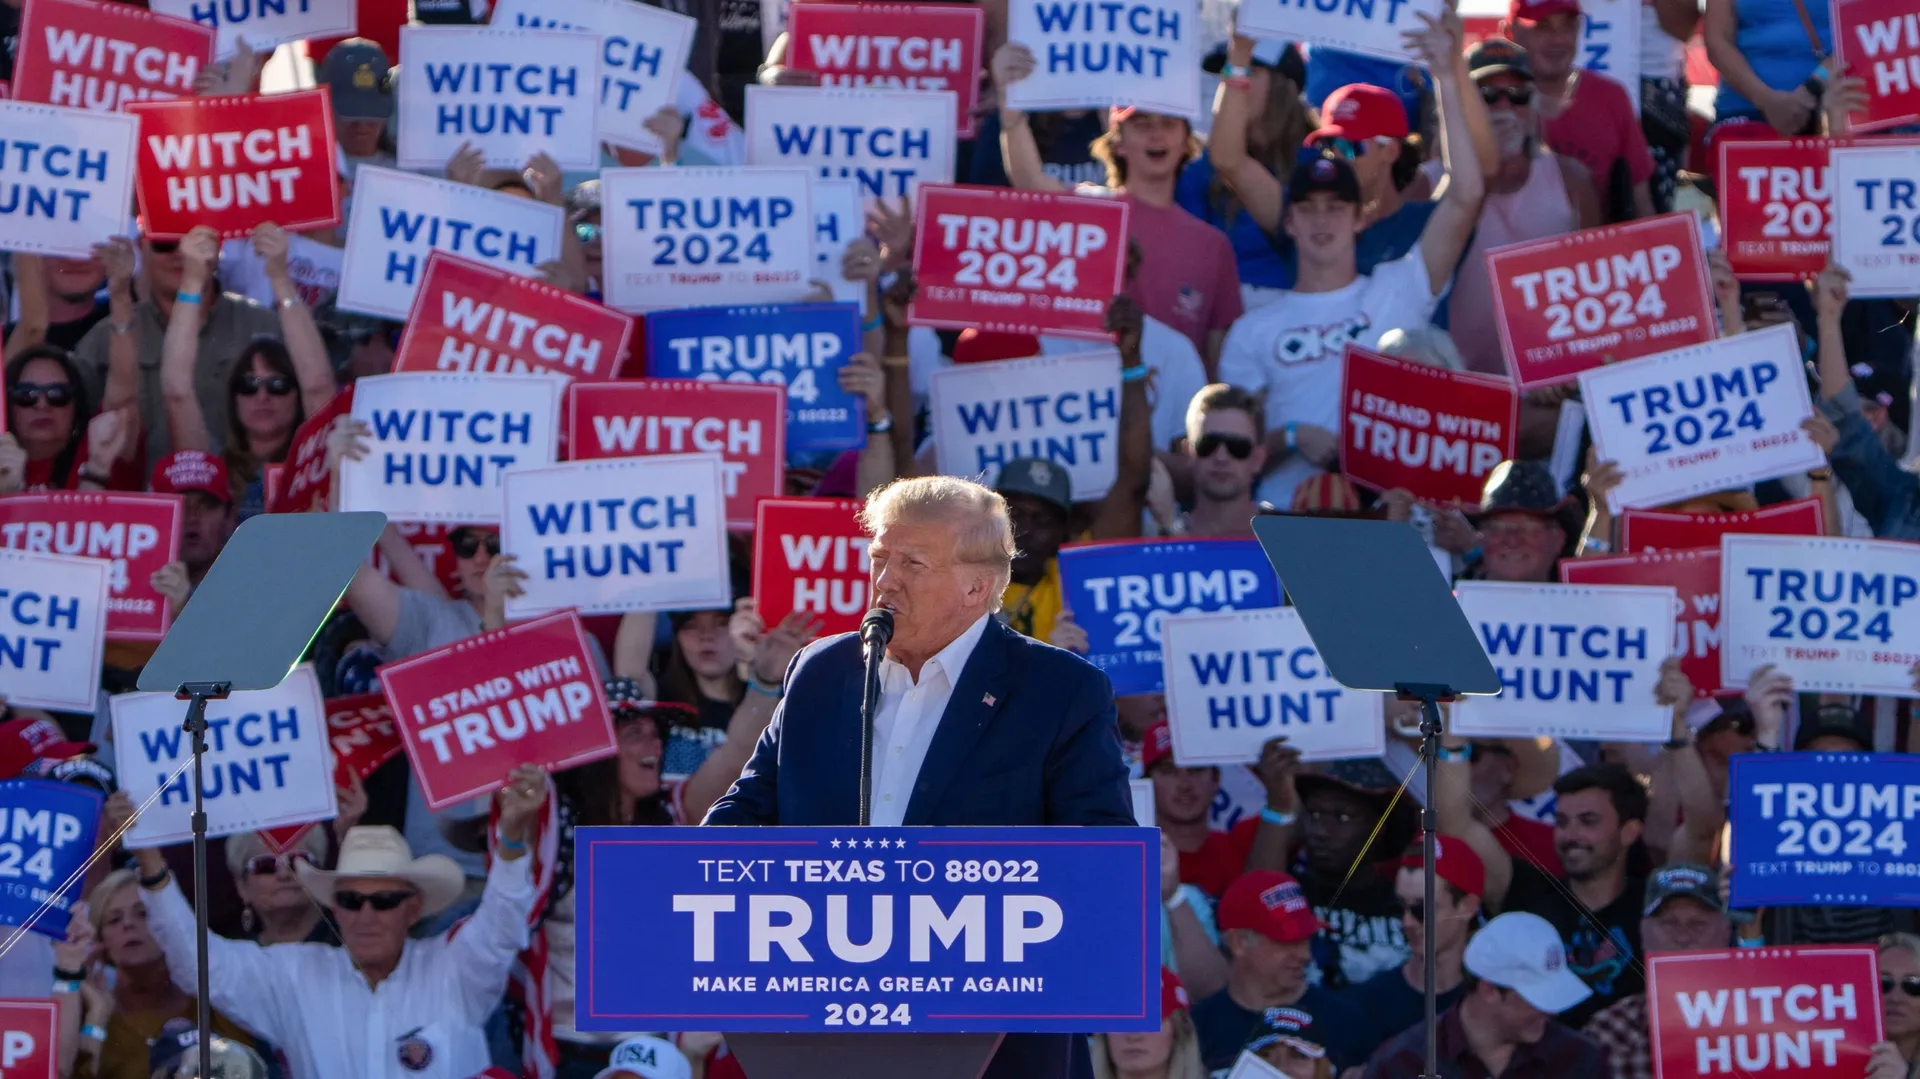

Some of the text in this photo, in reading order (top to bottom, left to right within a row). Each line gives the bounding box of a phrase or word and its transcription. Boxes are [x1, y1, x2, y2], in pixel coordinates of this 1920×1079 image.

[1036, 1, 1181, 41] WITCH
[1279, 0, 1407, 23] NT
[44, 26, 198, 89] WITCH
[809, 34, 961, 73] WITCH
[1048, 43, 1170, 77] HUNT
[51, 70, 178, 114] HUN
[426, 63, 577, 97] WITCH
[437, 105, 564, 137] HUNT
[148, 125, 312, 171] WITCH
[773, 124, 930, 159] WITCH
[166, 167, 302, 212] HUNT
[820, 167, 916, 198] NT
[627, 198, 794, 230] TRUMP
[380, 207, 537, 265] WITCH
[652, 232, 772, 266] 2024
[937, 213, 1107, 258] TRUMP
[1780, 241, 1829, 254] TRUM
[669, 272, 722, 285] TRUMP
[954, 250, 1078, 292] 2024
[1512, 244, 1682, 310] TRUMP
[927, 285, 1104, 312] TEXT TRUMP TO 88022
[1543, 283, 1668, 340] 2024
[441, 291, 602, 374] WITCH
[669, 332, 842, 372] TRUMP
[1525, 343, 1564, 363] TEXT
[1568, 332, 1622, 356] TRUMP
[1626, 327, 1647, 342] TO
[957, 388, 1116, 435] WITCH
[1610, 361, 1779, 424] TRUMP
[372, 410, 531, 445] WITCH
[1352, 389, 1501, 441] I STAND WITH
[1643, 400, 1766, 455] 2024
[592, 415, 762, 456] WITCH
[1348, 411, 1502, 478] TRUMP
[385, 453, 516, 488] HUNT
[1666, 449, 1721, 470] TRUMP
[527, 494, 697, 537] WITCH
[2, 520, 159, 558] TRUMP
[544, 540, 685, 580] HUNT
[793, 577, 872, 616] HU
[1084, 569, 1260, 613] TRUMP
[1747, 568, 1918, 607] TRUMP
[1479, 623, 1648, 660] WITCH
[1769, 606, 1893, 644] 2024
[1190, 646, 1333, 686] WITC
[1784, 647, 1841, 662] TRUMP
[412, 704, 426, 725] I
[428, 676, 513, 720] STAND
[514, 655, 581, 692] WITH
[1496, 667, 1634, 703] HUNT
[417, 681, 592, 764] TRUMP
[1208, 690, 1342, 729] HUNT
[139, 706, 300, 763] WTCH
[157, 753, 291, 806] HUNT
[1775, 819, 1908, 858] 2024
[698, 859, 1039, 883] TEXT TEXAS TO 88022
[1750, 861, 1787, 876] TEXT
[1794, 861, 1853, 876] TRUMP
[1858, 862, 1880, 876] TO
[672, 894, 1064, 964] TRUMP
[692, 976, 1044, 993] MAKE AMERICA GREAT AGAIN!
[824, 1002, 912, 1026] 2024
[1675, 983, 1857, 1028] WITCH
[616, 1042, 656, 1067] USA
[1696, 1029, 1845, 1075] HUNT
